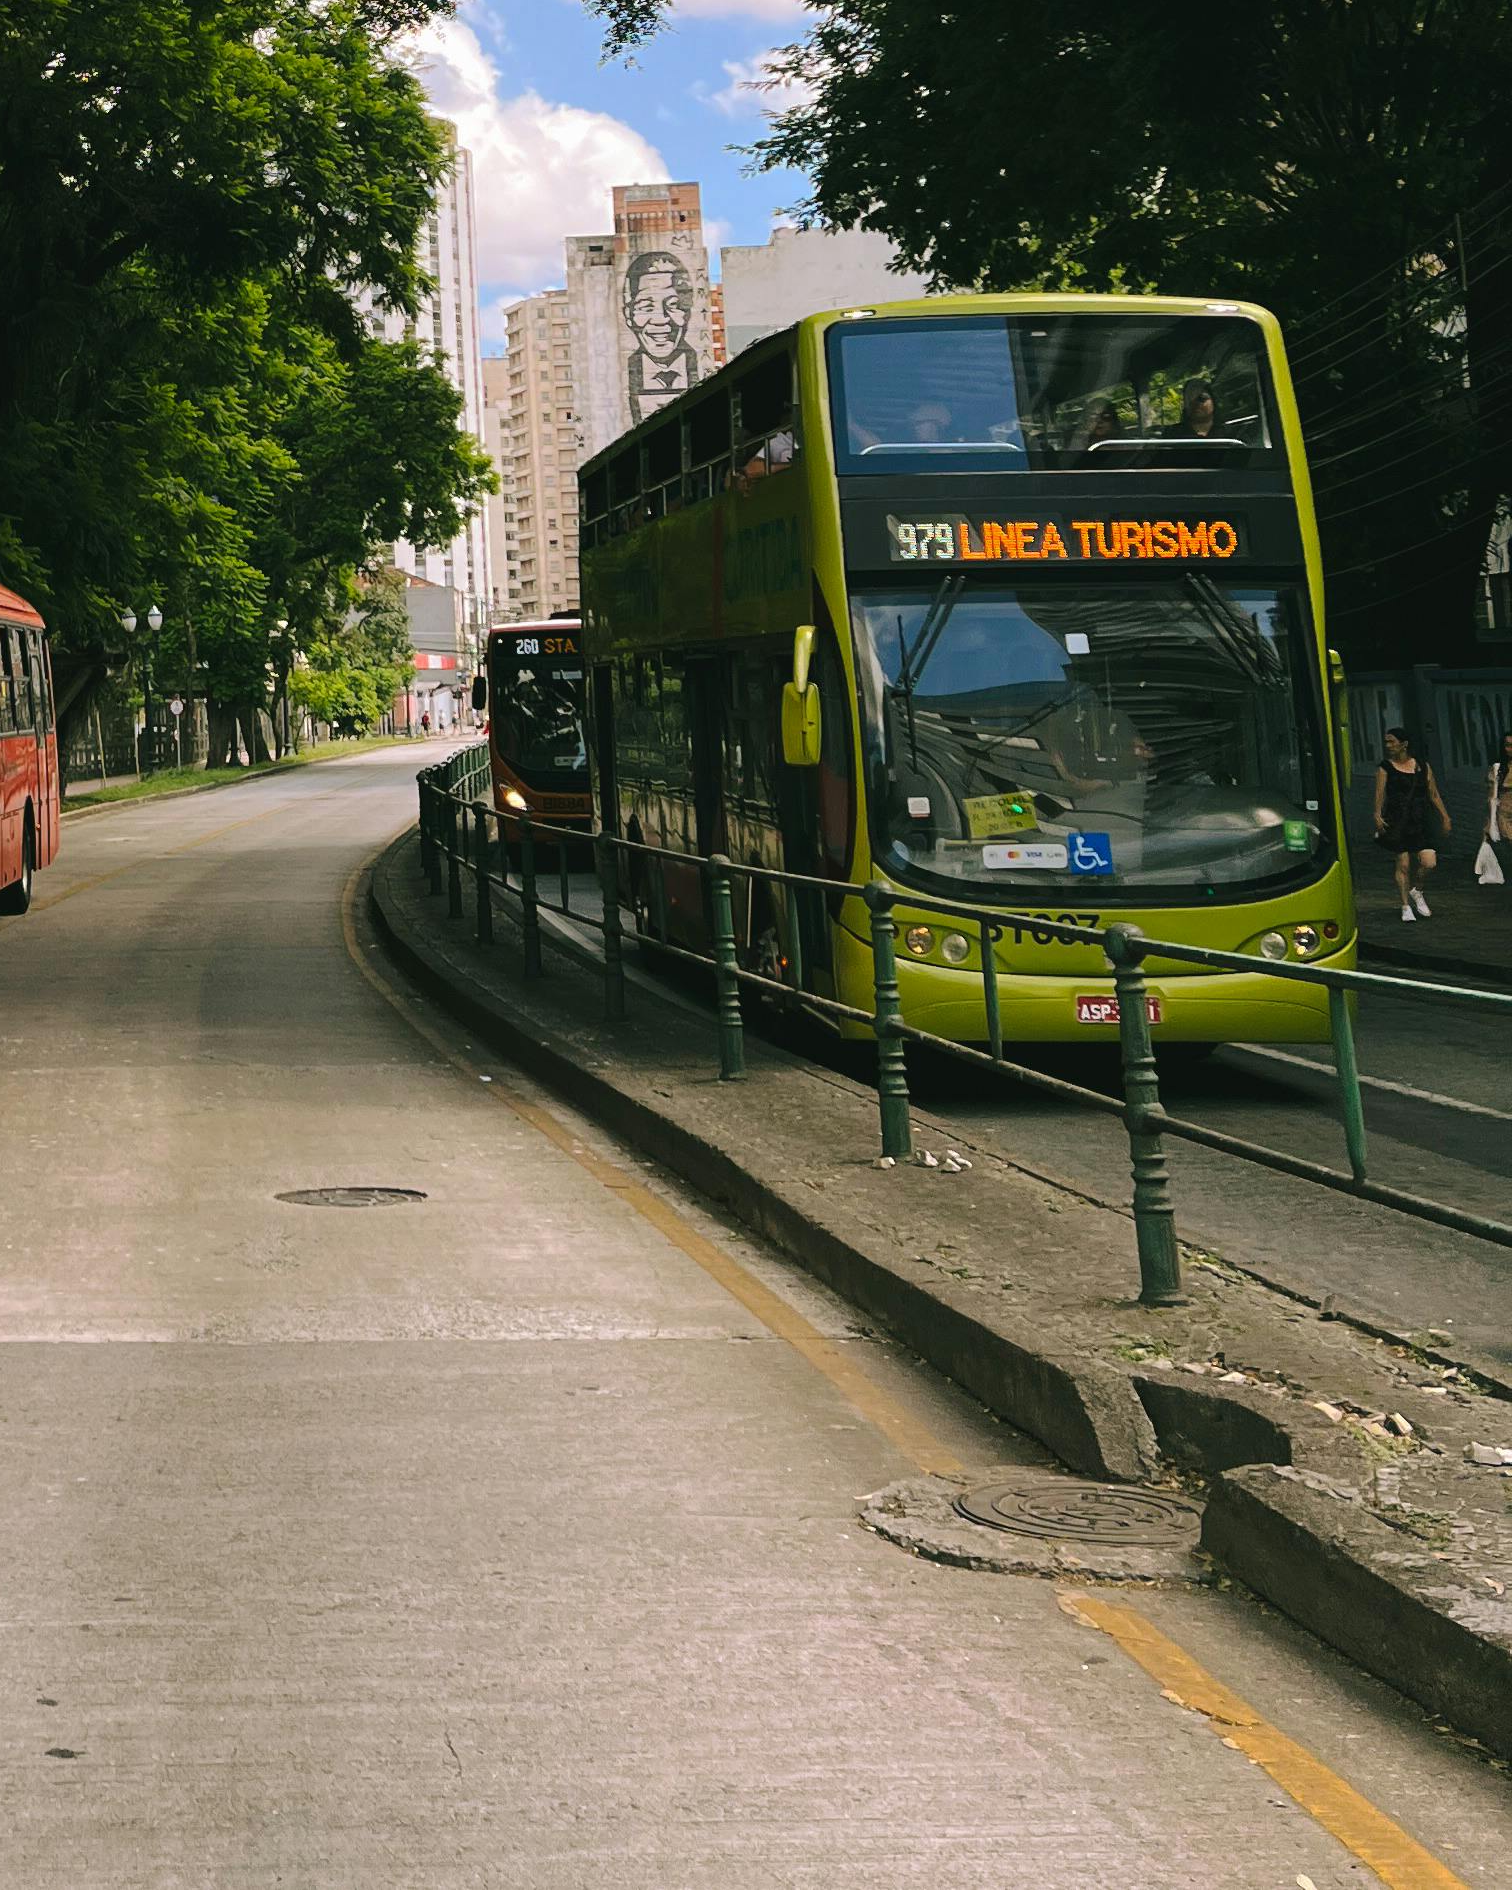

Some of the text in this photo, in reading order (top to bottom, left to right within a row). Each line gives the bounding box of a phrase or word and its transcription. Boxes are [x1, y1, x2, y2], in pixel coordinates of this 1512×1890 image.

[898, 520, 1239, 560] 979 LINEA TURISMO
[515, 638, 540, 655] 260
[1080, 1003, 1156, 1022] ASP-1
